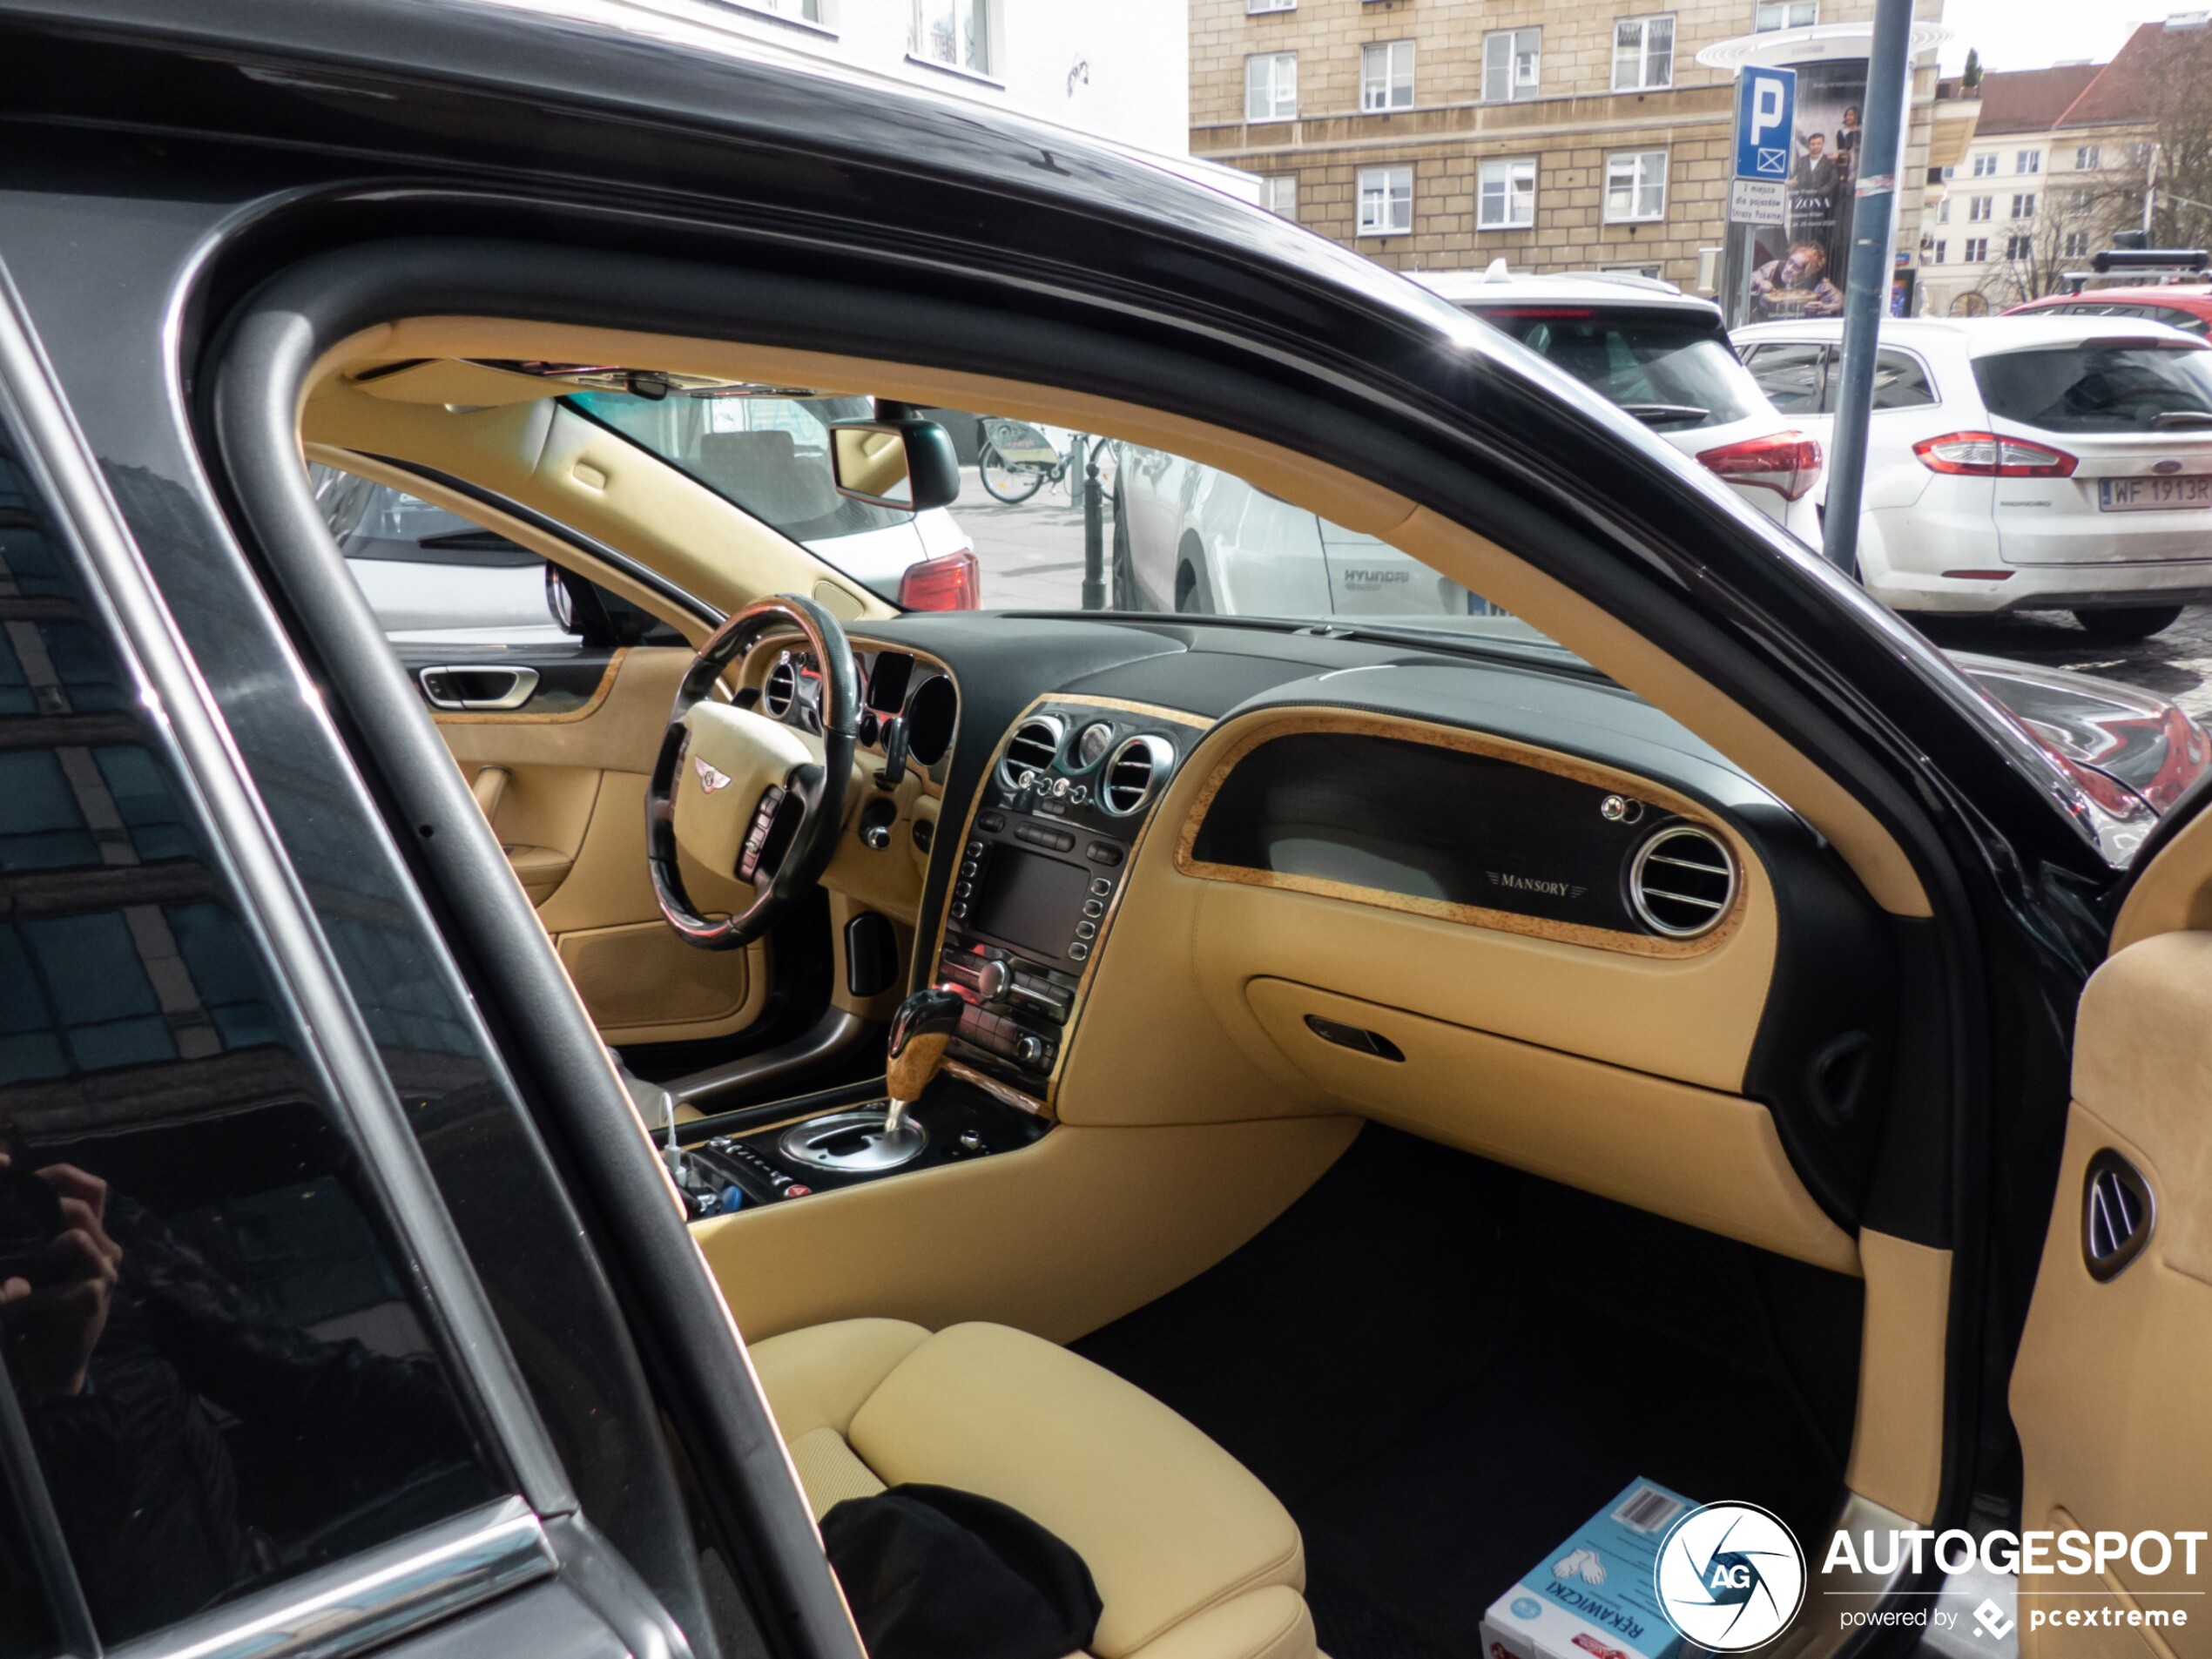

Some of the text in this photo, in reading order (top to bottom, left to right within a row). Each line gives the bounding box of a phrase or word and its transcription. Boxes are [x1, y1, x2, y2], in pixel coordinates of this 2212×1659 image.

[1750, 77, 1784, 145] P
[1736, 196, 1746, 205] dla
[2114, 479, 2210, 503] WF 1913R
[1345, 570, 1409, 583] HYUNDAI
[1501, 873, 1568, 896] MANSORY
[1546, 1581, 1644, 1639] RĘKAWICZKI
